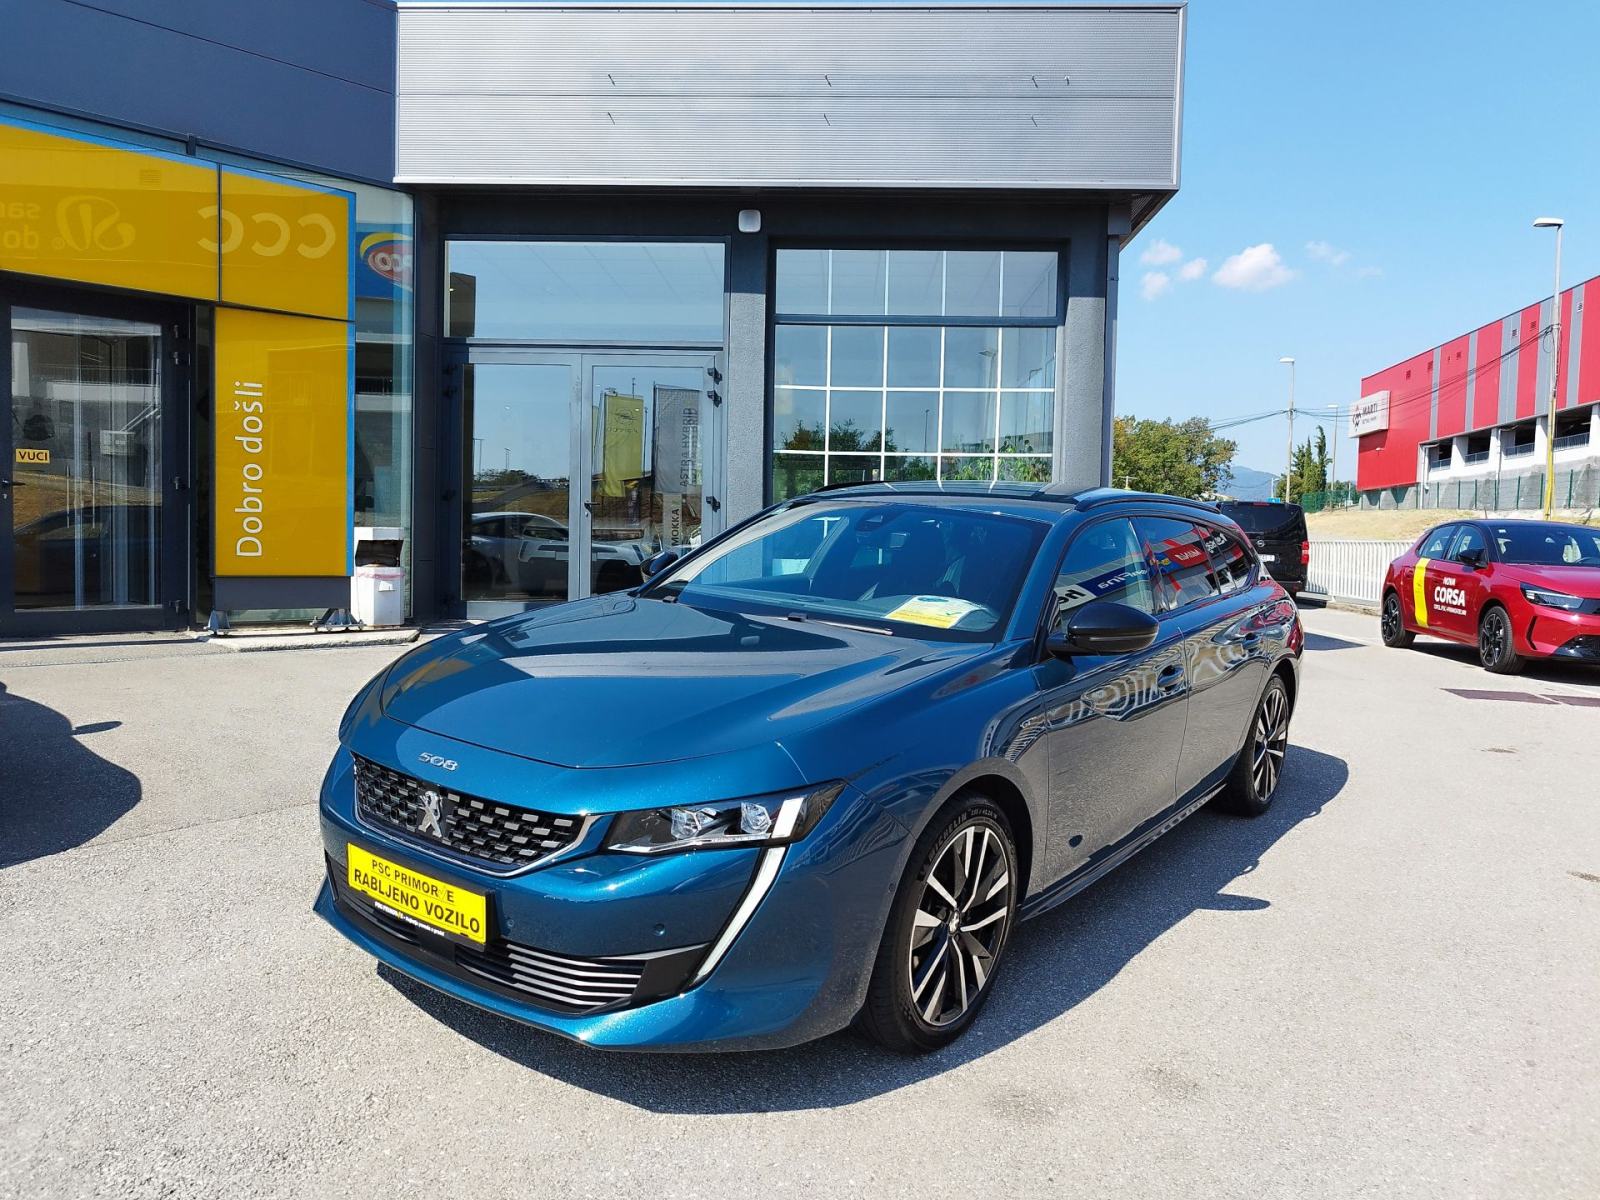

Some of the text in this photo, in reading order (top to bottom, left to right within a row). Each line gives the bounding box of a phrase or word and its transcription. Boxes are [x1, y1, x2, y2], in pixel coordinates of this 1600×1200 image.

[18, 450, 49, 462] VUCI
[234, 381, 263, 558] Dobro došli
[680, 452, 690, 487] ASTRA
[671, 508, 680, 546] MOKKA
[1434, 586, 1466, 607] CORSA
[418, 752, 458, 772] 508
[371, 859, 455, 902] PSC PRIMORE
[354, 868, 420, 910] RABLJENO
[424, 899, 480, 933] VOZILO
